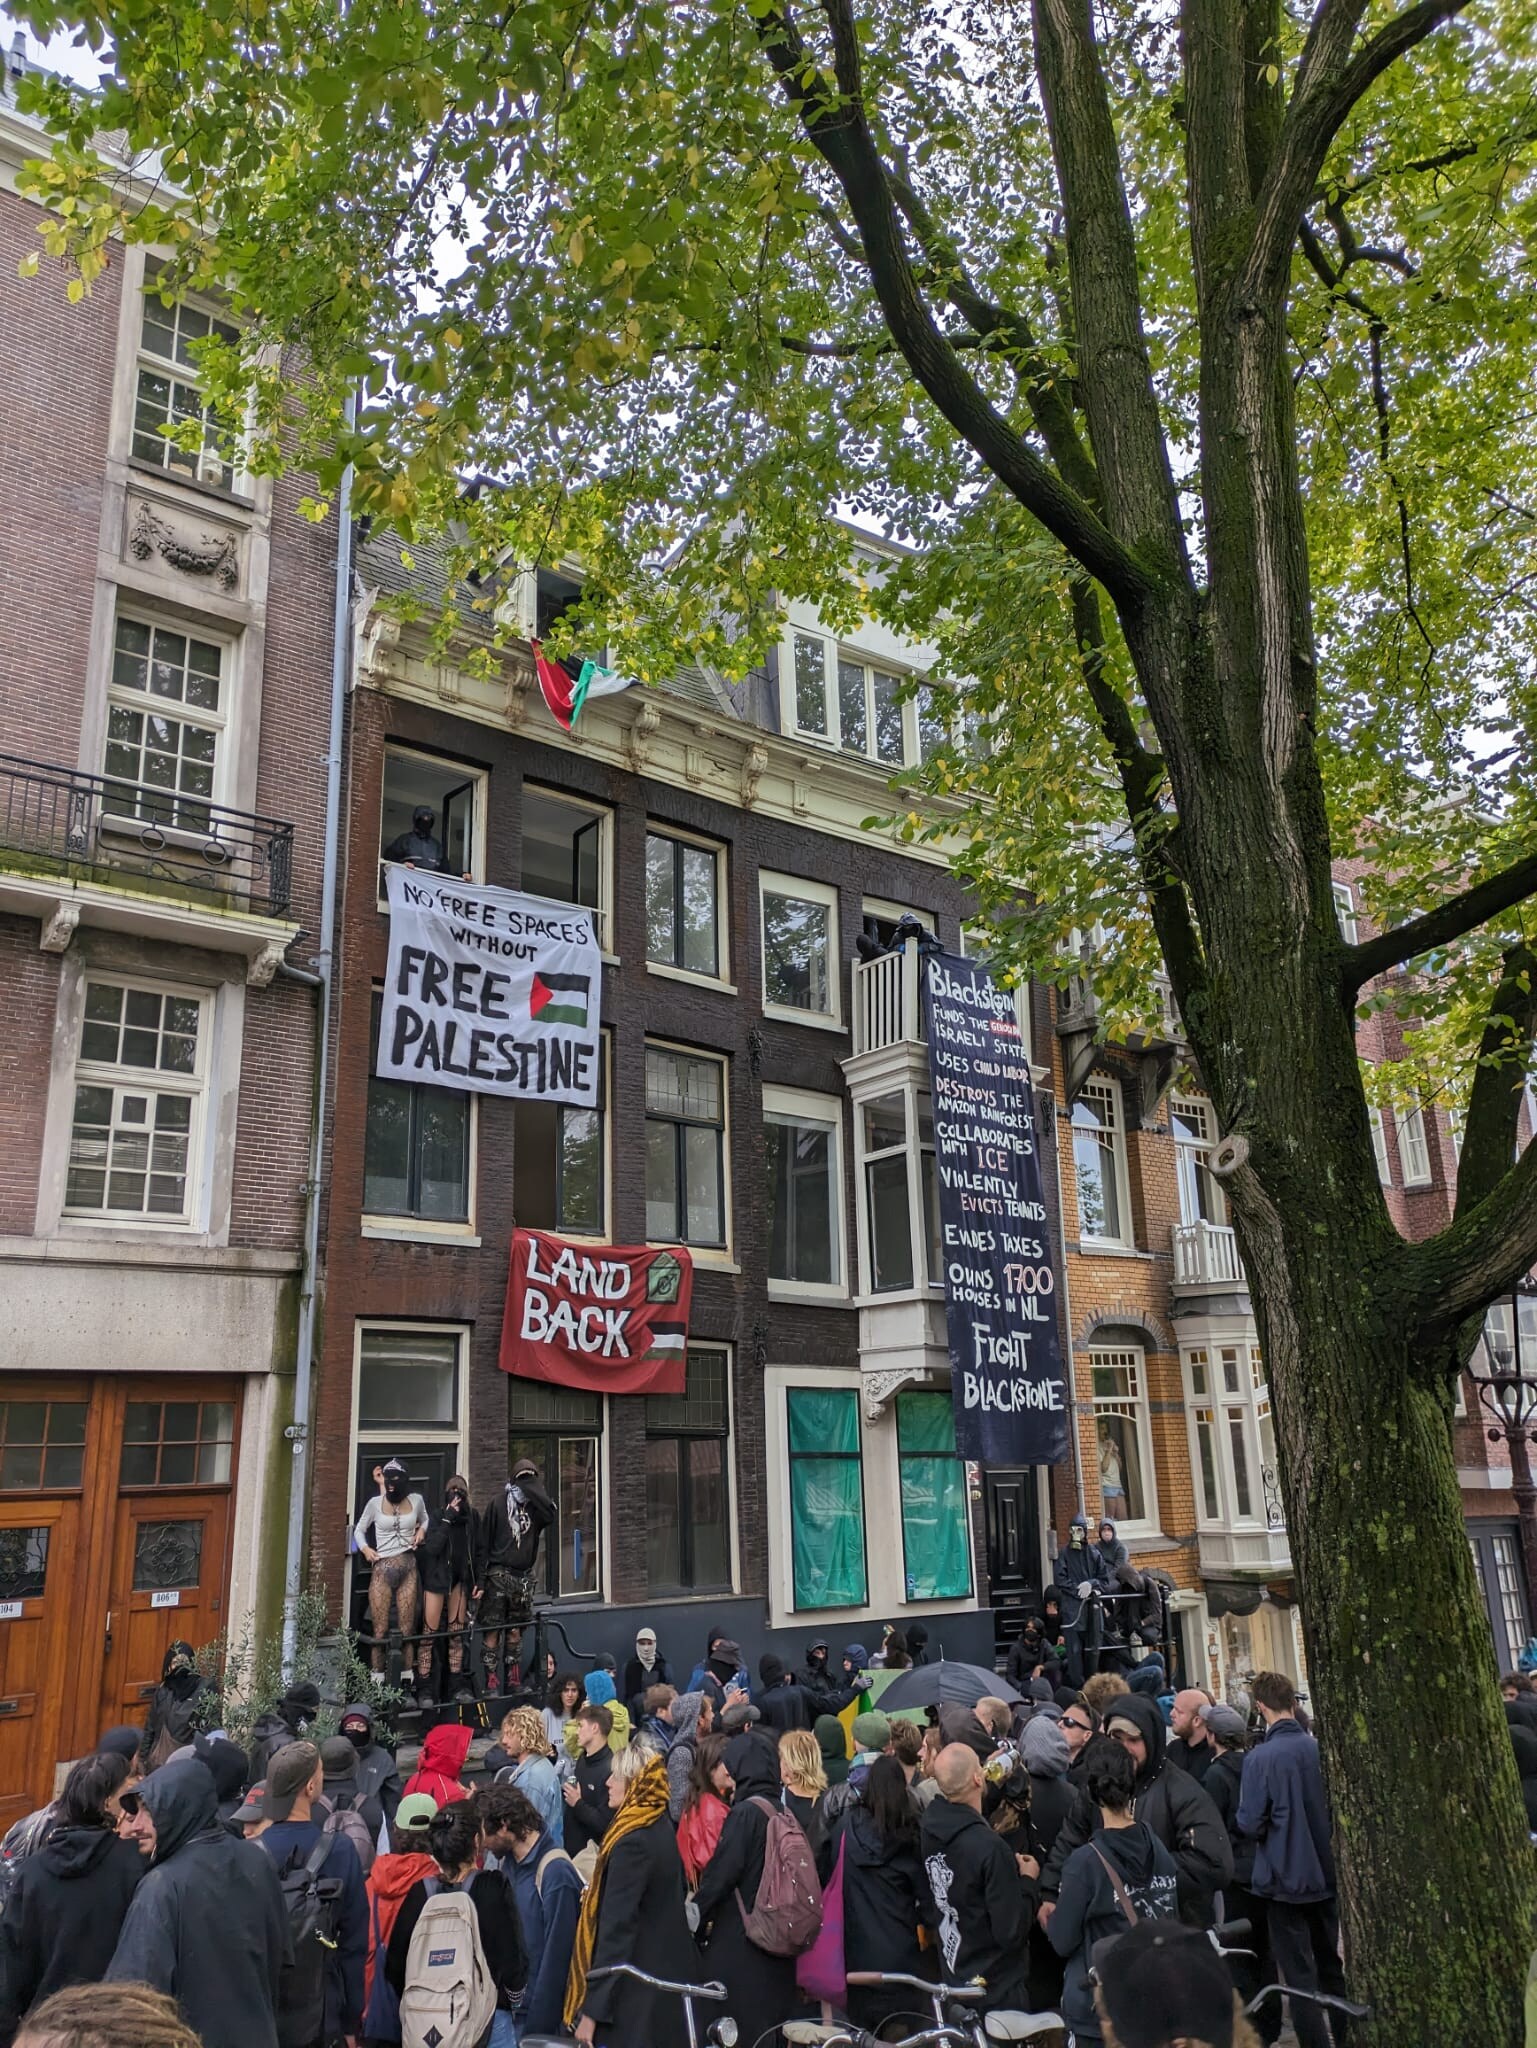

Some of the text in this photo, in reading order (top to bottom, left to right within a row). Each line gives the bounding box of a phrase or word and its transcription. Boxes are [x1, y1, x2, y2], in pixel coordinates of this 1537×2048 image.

[403, 882, 434, 908] NO
[449, 926, 538, 962] WITHOUT
[397, 944, 511, 1020] FREE
[933, 1003, 966, 1025] FUNDS
[968, 1016, 990, 1031] THE
[391, 1005, 594, 1093] PALESTINE
[935, 1022, 1027, 1060] ISRAELI STATE
[936, 1050, 1029, 1084] USES CHILD LABOR
[935, 1075, 1024, 1108] DESTROYS THE
[938, 1096, 1034, 1131] AMAZON RAINFOREST
[937, 1121, 1033, 1155] COLLABORATES
[941, 1139, 1009, 1172] WITH ICE
[940, 1166, 1018, 1200] VIOLENTLY
[960, 1193, 1003, 1216] EVICTS
[944, 1224, 1044, 1259] EVADES TAXES
[526, 1238, 632, 1300] LAND
[1003, 1263, 1054, 1295] 1700
[520, 1287, 632, 1358] BACK
[1005, 1297, 1017, 1313] IN
[1021, 1296, 1050, 1322] NL
[971, 1321, 1032, 1372] FIGHT
[963, 1371, 1065, 1413] BLACKSTONE
